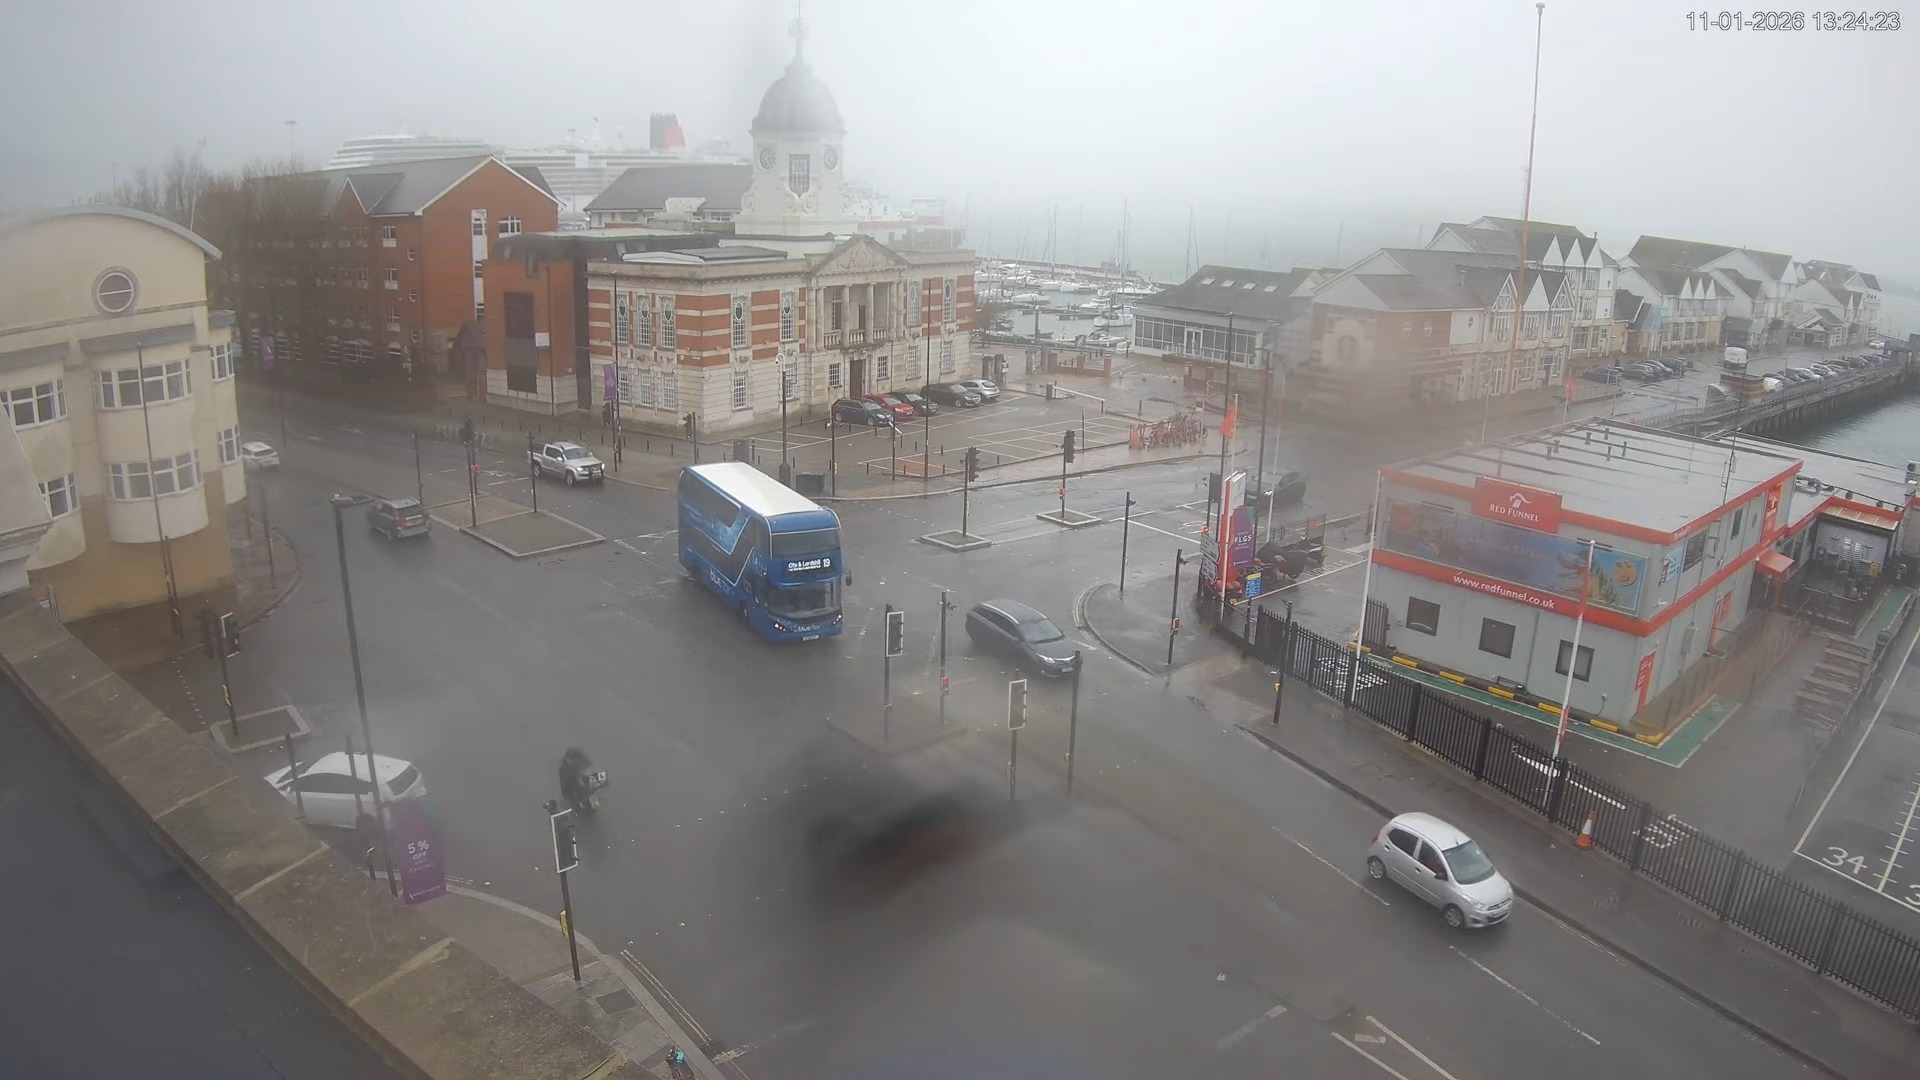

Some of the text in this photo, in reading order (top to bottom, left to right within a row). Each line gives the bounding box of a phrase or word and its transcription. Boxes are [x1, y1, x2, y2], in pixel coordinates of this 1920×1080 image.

[1489, 503, 1539, 523] RED FUNNEL
[823, 558, 831, 567] 19
[1453, 574, 1556, 610] www.redfunnel.co.uk
[413, 851, 426, 860] OFF
[1822, 846, 1868, 875] 34
